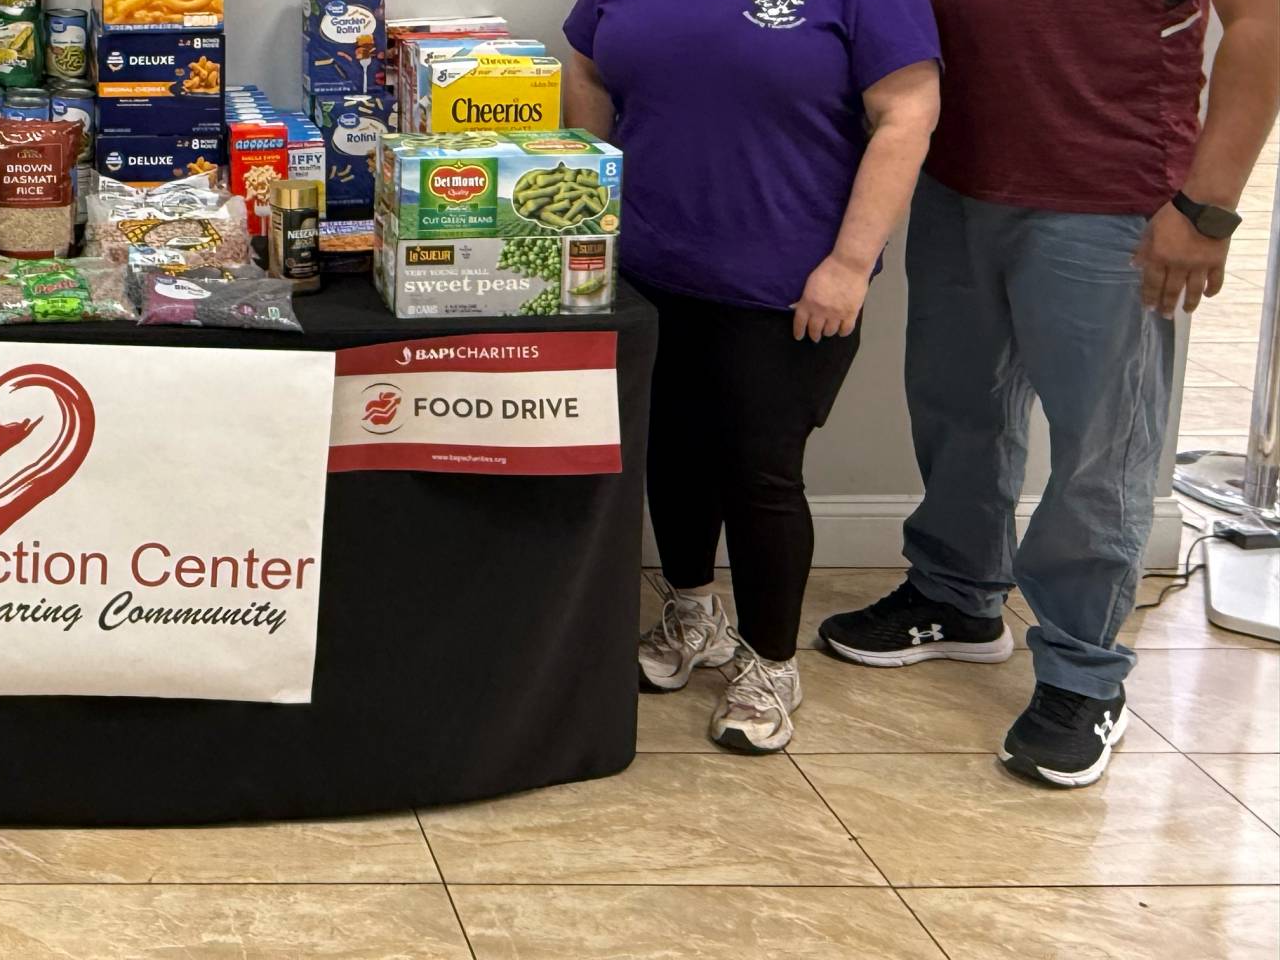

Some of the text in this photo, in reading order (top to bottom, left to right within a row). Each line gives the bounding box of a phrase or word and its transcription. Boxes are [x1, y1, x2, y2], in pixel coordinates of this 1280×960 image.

[330, 17, 366, 27] Garden
[193, 38, 202, 49] 8
[129, 55, 175, 66] DELUXE
[451, 97, 543, 123] Cheerios
[346, 132, 377, 143] Rotini
[191, 138, 200, 149] 8
[128, 156, 174, 166] DELUXE
[289, 153, 323, 165] IFFY
[6, 163, 53, 173] BROWN
[605, 161, 617, 177] 8
[2, 175, 57, 184] BASMATI
[433, 174, 486, 187] Del Monte
[15, 186, 44, 195] RICE
[447, 189, 469, 198] Quality
[422, 215, 493, 225] CUT GREEN BEANS
[419, 248, 452, 262] SUEUR
[404, 276, 531, 296] sweet peas
[415, 305, 438, 314] CANS
[413, 397, 580, 420] FOOD DRIVE
[431, 453, 507, 465] www.bapscharities.org
[130, 542, 315, 590] Center
[98, 590, 288, 634] Community
